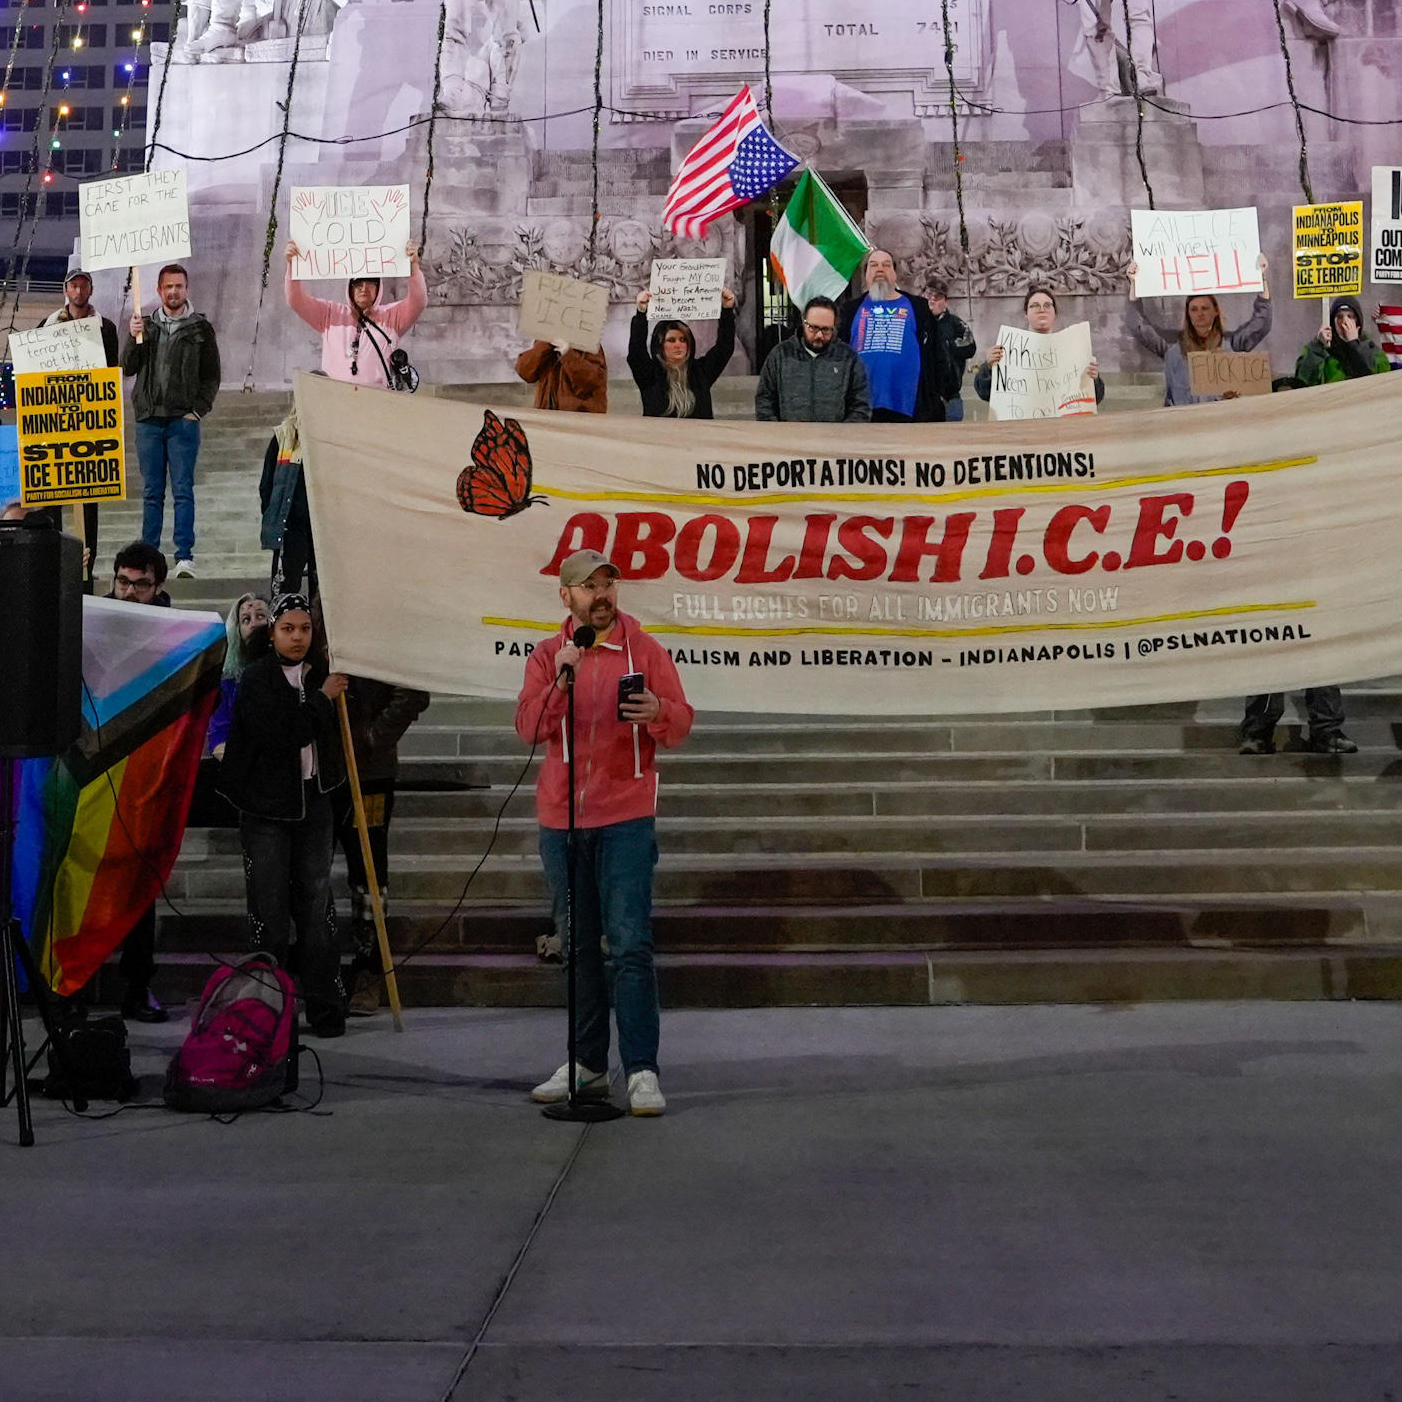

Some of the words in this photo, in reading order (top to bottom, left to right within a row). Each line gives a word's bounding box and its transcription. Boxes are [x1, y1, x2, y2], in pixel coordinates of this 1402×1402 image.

[643, 5, 693, 16] SIGNAL
[708, 3, 752, 15] CORPS
[824, 23, 879, 37] TOTAL
[643, 50, 674, 62] DIED
[686, 49, 699, 61] IN
[711, 48, 770, 61] SERVICE
[87, 178, 133, 200] FIRST
[142, 170, 180, 186] THEY
[85, 200, 119, 217] CAME
[128, 194, 149, 208] FOR
[156, 188, 179, 200] THE
[312, 219, 386, 246] COLD
[1296, 211, 1359, 229] INDIANAPOLIS
[88, 222, 190, 258] IMMIGRANTS
[1296, 230, 1359, 249] MINNEAPOLIS
[295, 246, 398, 277] MURDER
[1161, 249, 1261, 292] HELL
[1296, 251, 1360, 267] STOP
[1297, 268, 1314, 286] ICE
[1315, 266, 1359, 284] TERROR
[537, 299, 594, 332] ICE
[15, 329, 46, 347] ICE
[52, 325, 70, 339] are
[72, 319, 92, 333] the
[27, 335, 81, 359] terrorists
[39, 356, 60, 370] not
[61, 352, 81, 367] the
[1191, 356, 1239, 385] FUCK
[1240, 356, 1270, 383] ICE
[47, 374, 89, 384] FROM
[21, 381, 117, 407] INDIANAPOLIS
[22, 408, 117, 435] MINNEAPOLIS
[59, 404, 81, 414] TO
[23, 439, 120, 462] STOP
[24, 462, 51, 488] ICE
[54, 458, 120, 486] TERROR
[697, 463, 725, 489] NO
[734, 459, 906, 491] DEPORTATIONS!
[915, 462, 945, 487] NO
[953, 452, 1096, 486] DETENTIONS!
[539, 512, 977, 584] ABOLISH
[978, 480, 1251, 583] I.C.E.!
[672, 593, 725, 621] FULL
[731, 595, 809, 622] RIGHTS
[818, 594, 859, 621] FOR
[869, 594, 907, 622] ALL
[918, 588, 1059, 623] IMMIGRANTS
[1068, 586, 1120, 613] NOW
[495, 640, 535, 660] PAR
[749, 650, 792, 667] AND
[801, 647, 933, 668] LIBERATION
[959, 642, 1116, 668] INDIANAPOLIS
[1137, 623, 1312, 655] @PSLNATIONAL
